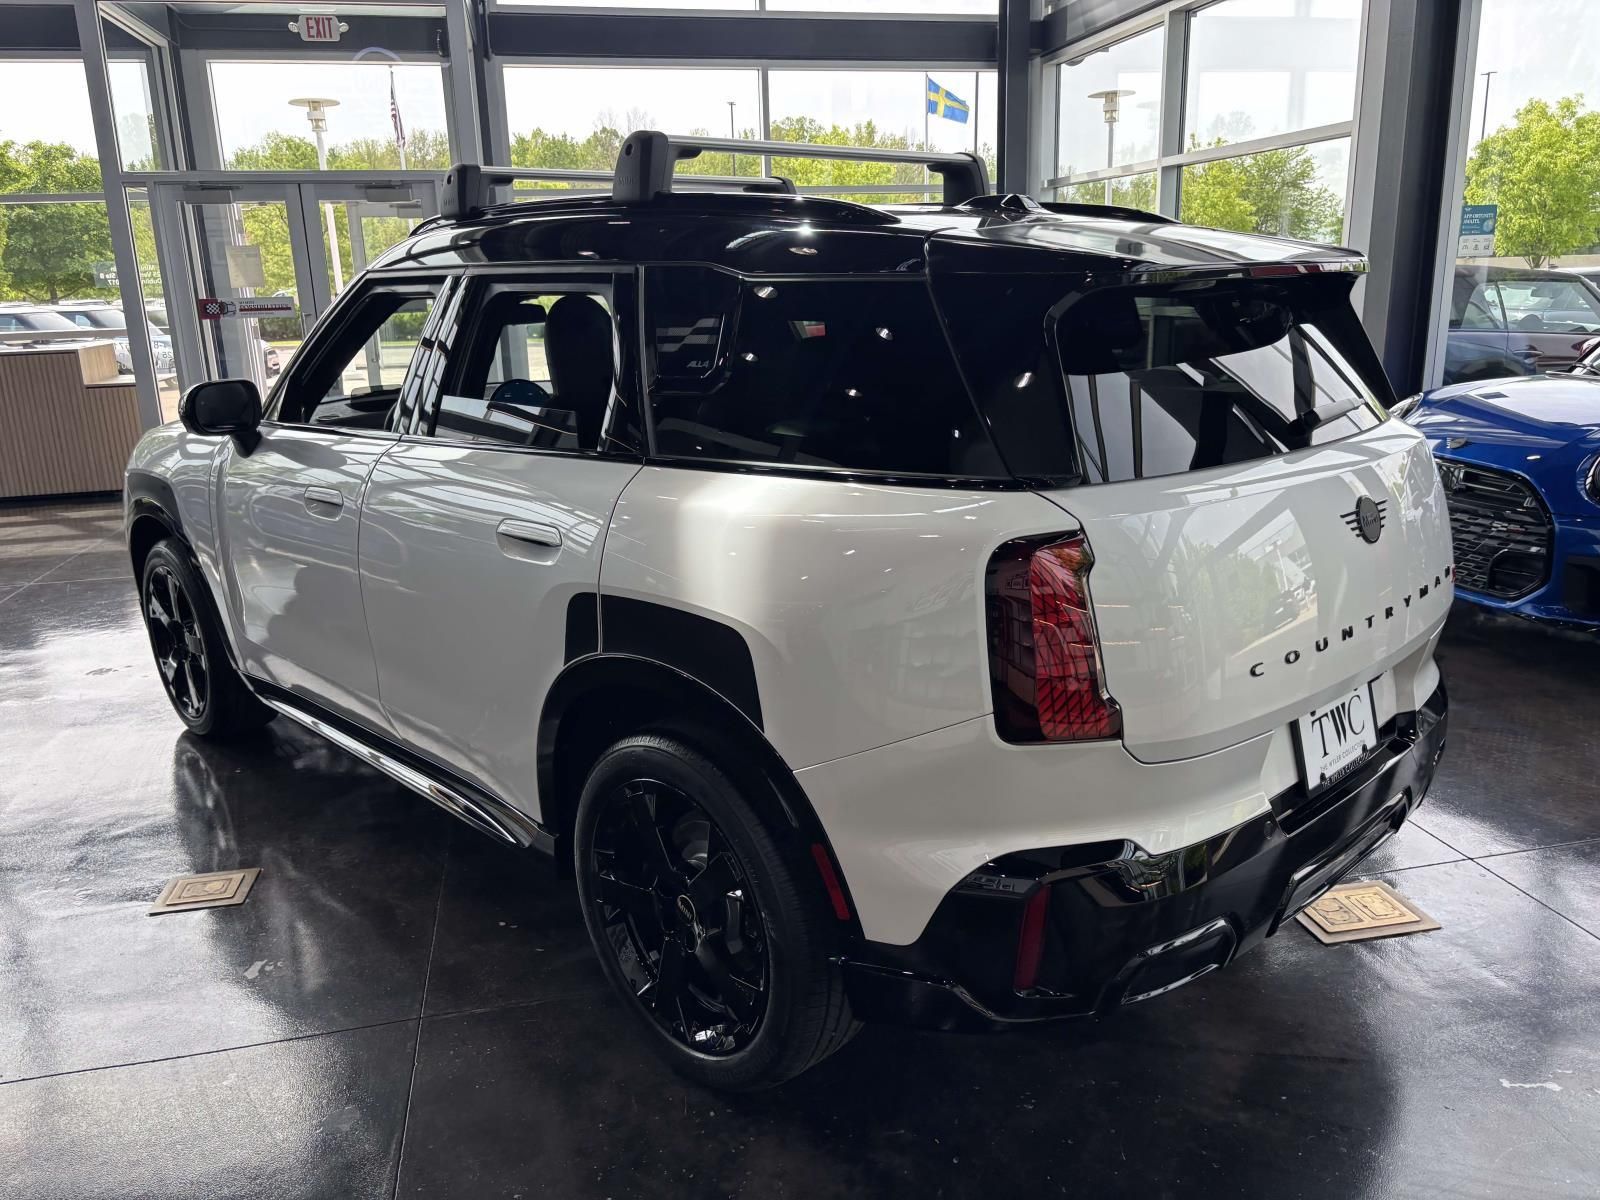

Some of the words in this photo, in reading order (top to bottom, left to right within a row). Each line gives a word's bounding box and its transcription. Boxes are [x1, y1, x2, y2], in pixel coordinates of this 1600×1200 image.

[305, 16, 333, 39] EXIT
[1250, 566, 1451, 677] COUNTRYMAN
[1311, 695, 1365, 758] TWC
